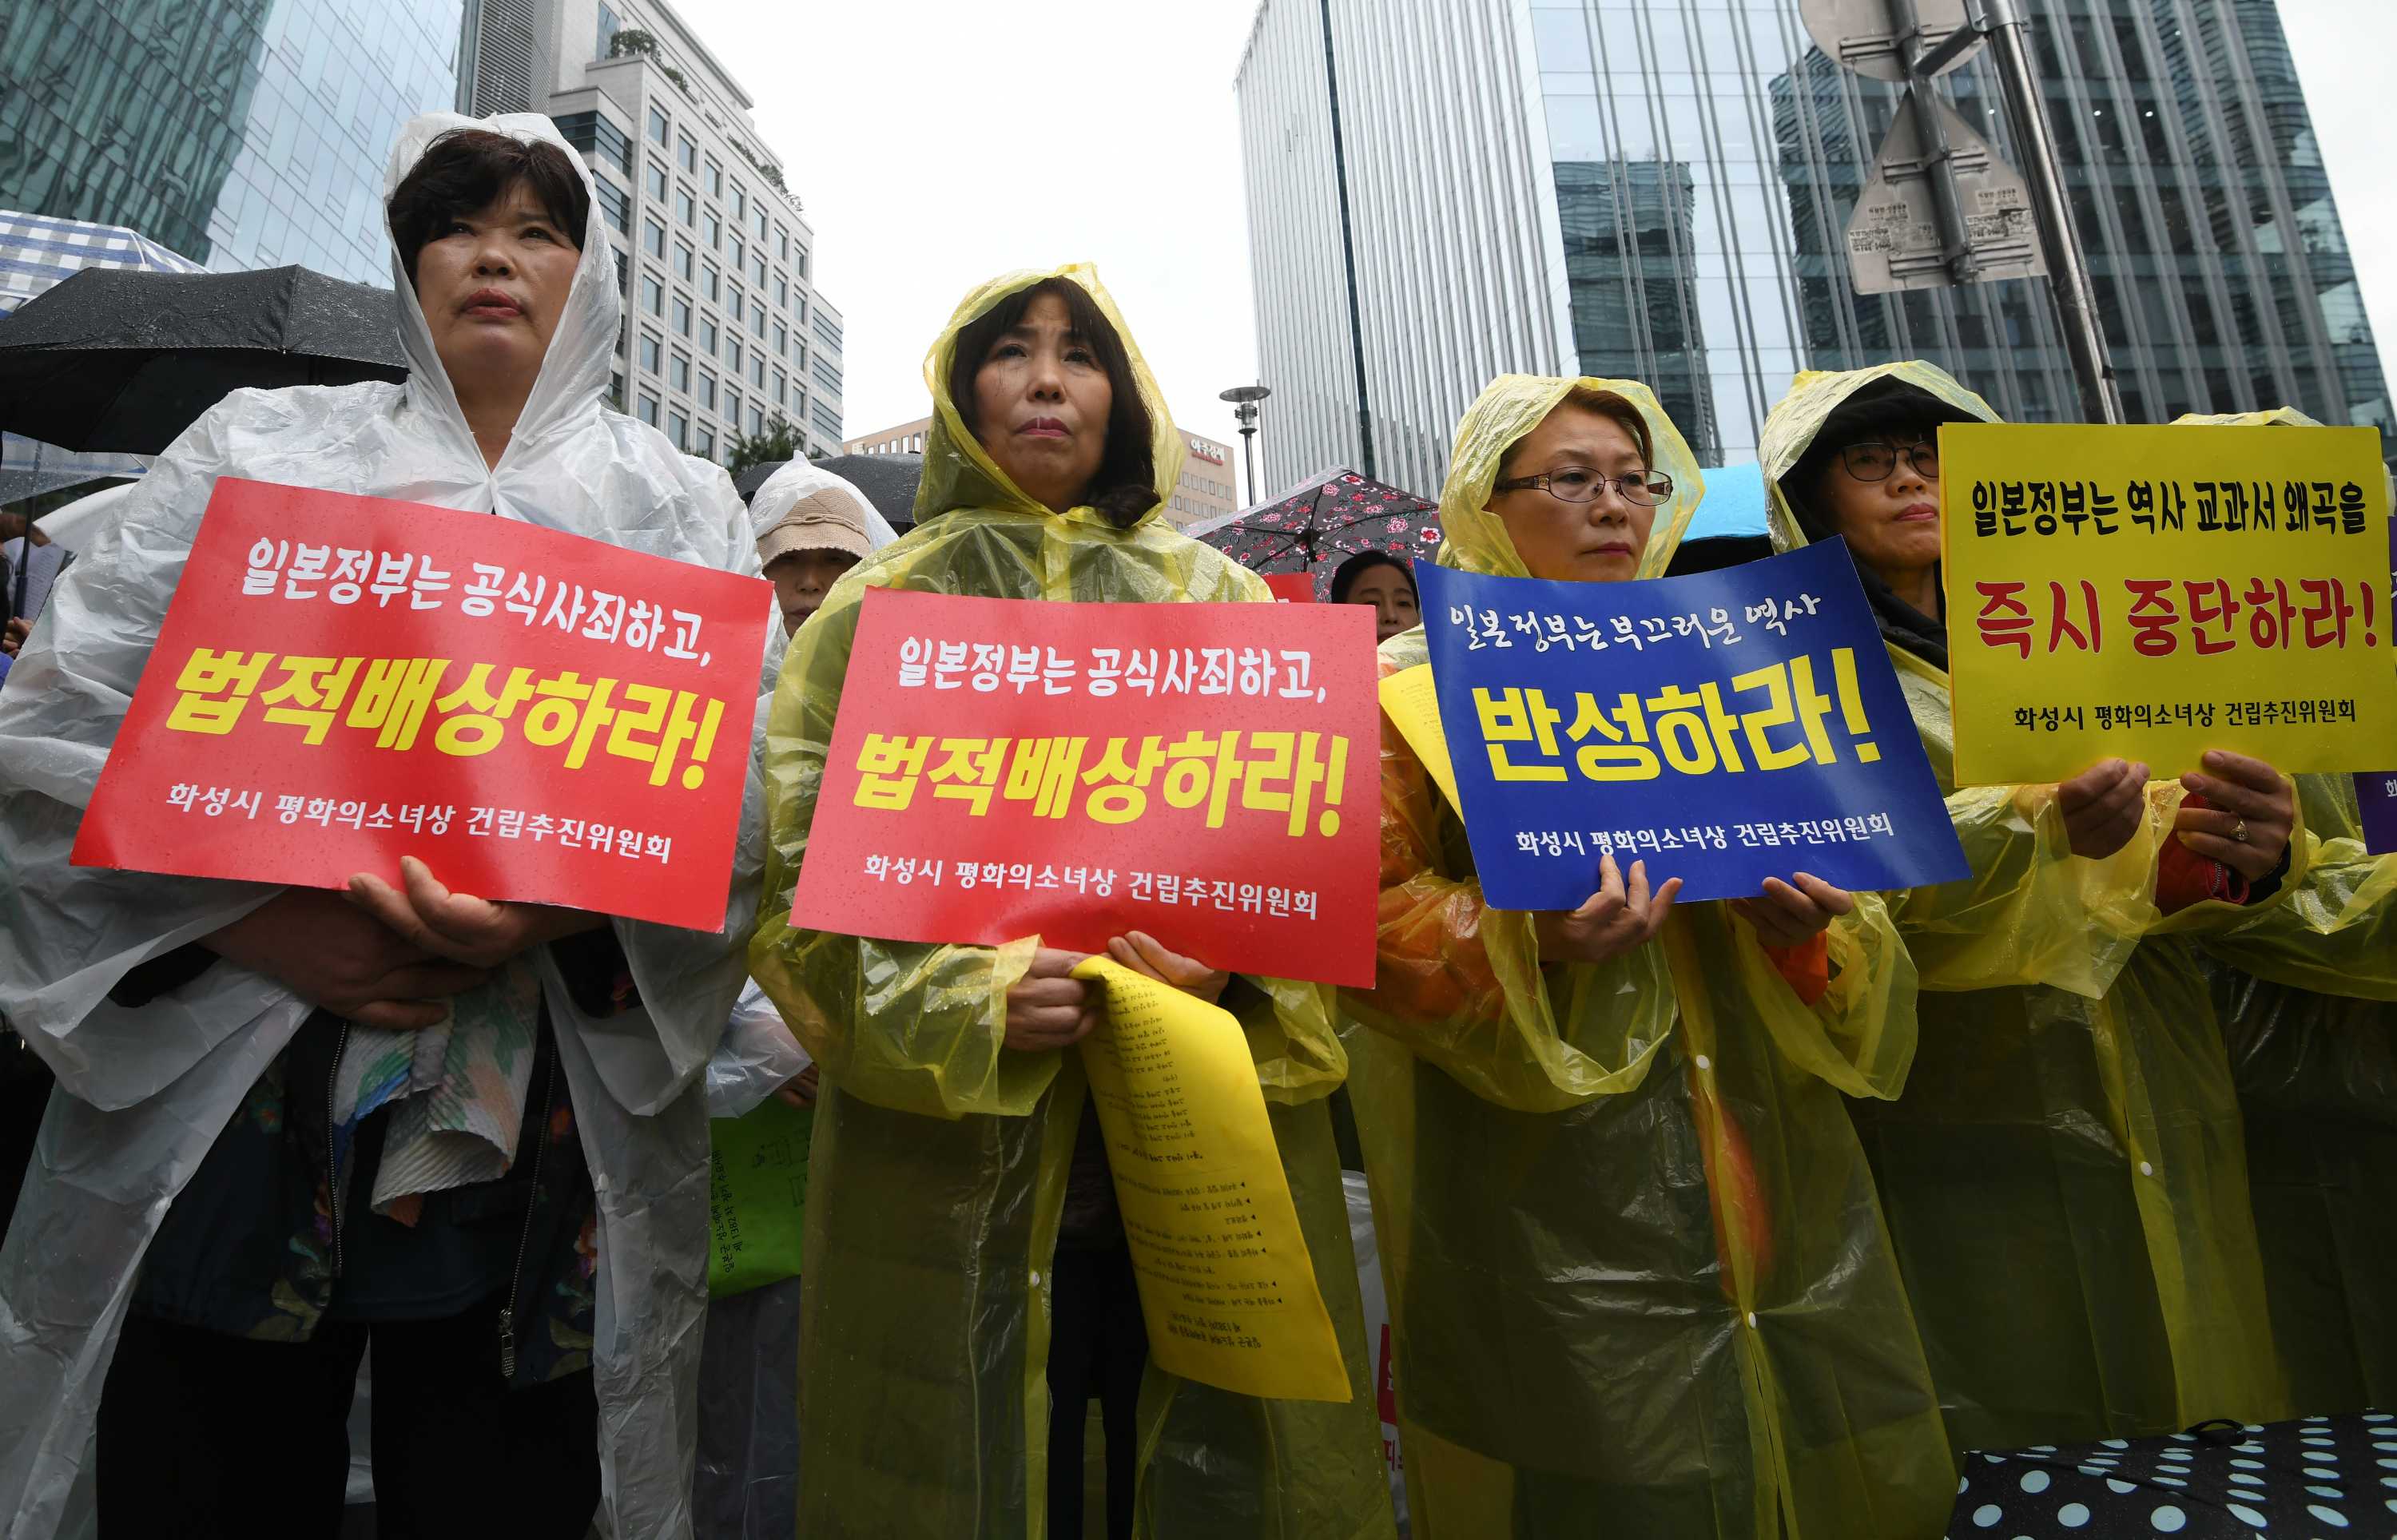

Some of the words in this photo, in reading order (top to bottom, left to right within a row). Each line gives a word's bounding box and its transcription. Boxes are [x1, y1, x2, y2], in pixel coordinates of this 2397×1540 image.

[1972, 480, 2119, 538] 일본정부는
[2127, 480, 2187, 534] 역사
[2193, 481, 2276, 532] 교과서
[2284, 480, 2366, 535] 왜곡을
[241, 537, 451, 610] 일본정부는
[460, 562, 711, 667] 공식사죄하고,
[1450, 604, 1608, 653] 일본정부는
[1610, 607, 1742, 651] 부끄러운
[1744, 593, 1821, 636] 역사
[1977, 580, 2101, 660] 즉시
[2124, 578, 2375, 656] 중단하라!
[898, 636, 1076, 696] 일본정부는
[1087, 647, 1326, 704] 공식사죄하고,
[165, 647, 725, 790] 법적배상하라!
[1473, 647, 1881, 782] 반성하라!
[2014, 706, 2084, 732] 화성시
[2094, 703, 2216, 730] 평화의소녀상
[2225, 699, 2355, 726] 건립추진위원회
[853, 729, 1350, 837] 법적배상하라!
[165, 783, 263, 820] 화성시
[275, 795, 456, 835] 평화의소녀상
[467, 807, 672, 864] 건립추진위원회
[1516, 831, 1585, 856] 화성시
[1589, 825, 1727, 857] 평화의소녀상
[1733, 812, 1894, 847] 건립추진위원회
[864, 854, 943, 887] 화성시
[955, 862, 1118, 897] 평화의소녀상
[1128, 871, 1317, 920] 건립추진위원회
